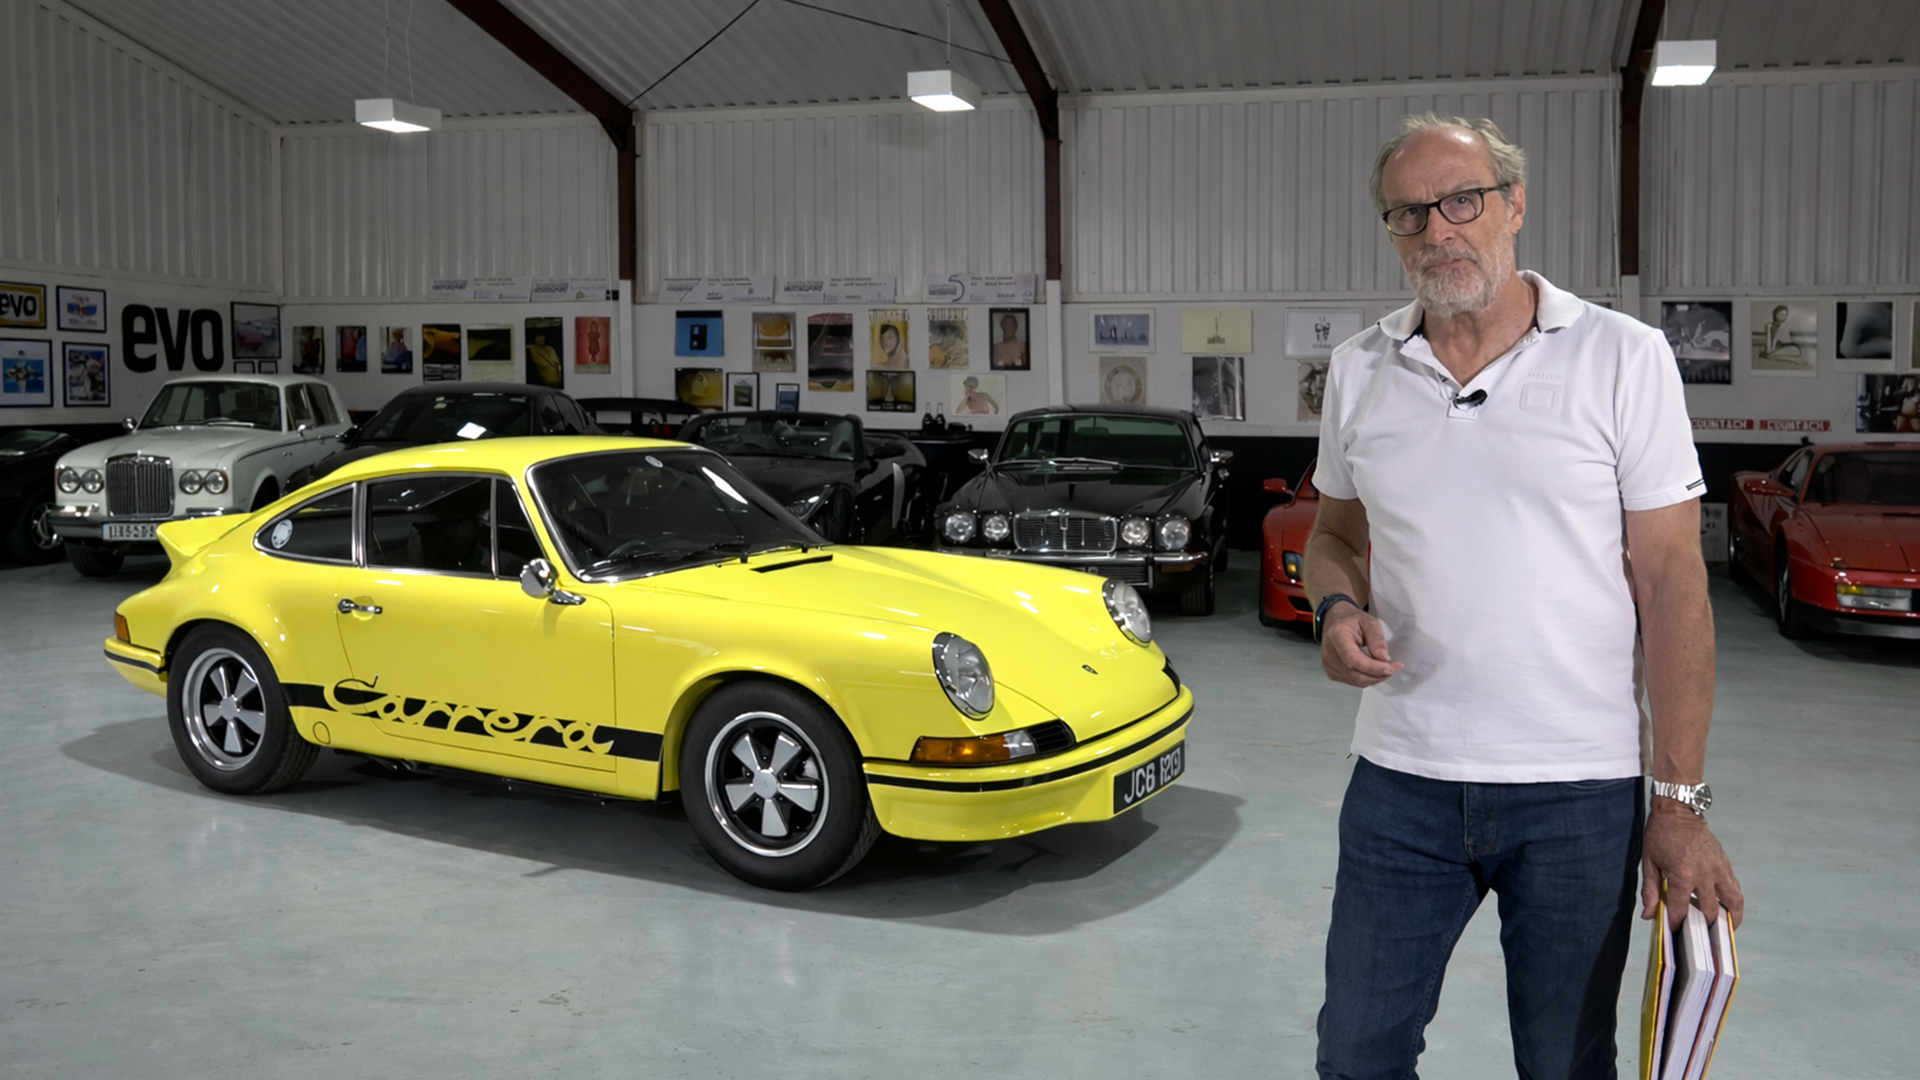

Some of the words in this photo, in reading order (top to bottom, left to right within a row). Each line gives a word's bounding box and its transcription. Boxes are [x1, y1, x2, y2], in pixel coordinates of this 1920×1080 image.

[121, 303, 224, 373] evo
[1766, 420, 1824, 431] COUNTACH
[323, 675, 614, 756] Carrera
[1124, 763, 1155, 804] JCB
